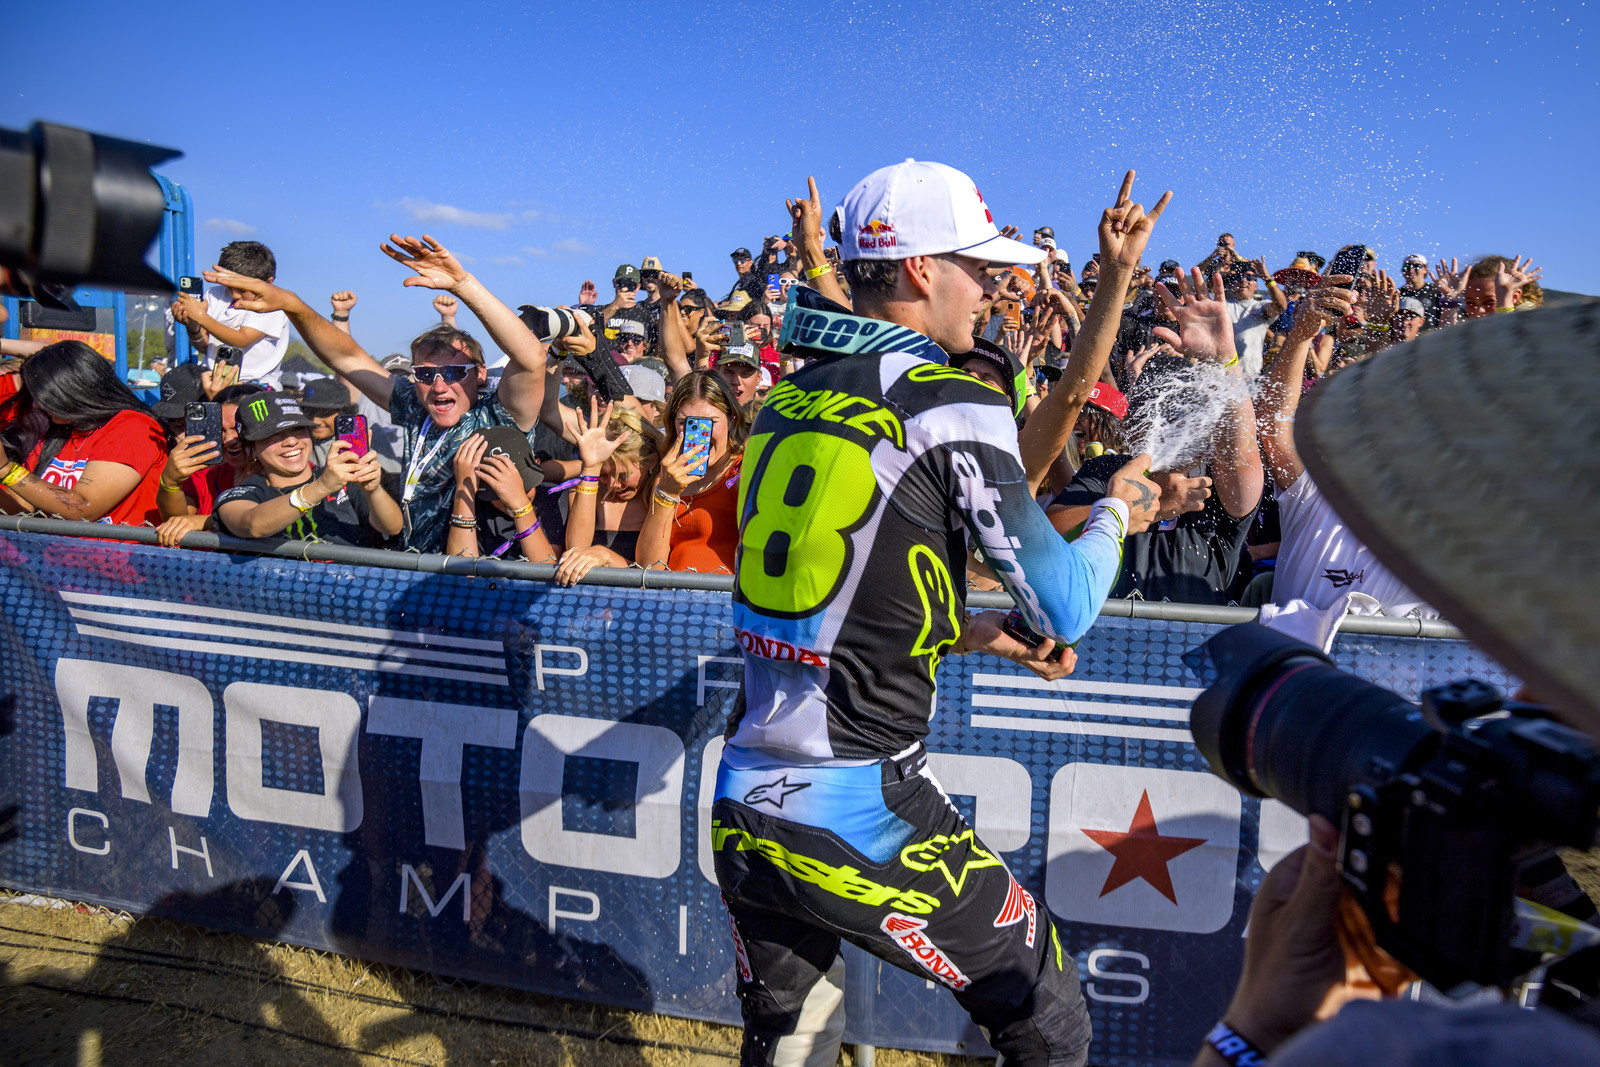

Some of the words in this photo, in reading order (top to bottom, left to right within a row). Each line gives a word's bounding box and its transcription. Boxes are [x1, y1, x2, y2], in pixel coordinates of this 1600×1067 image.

[859, 238, 876, 248] Red
[878, 236, 896, 247] Bull
[971, 347, 1005, 365] wasaki
[711, 820, 941, 915] inestars
[901, 931, 967, 991] HONDA
